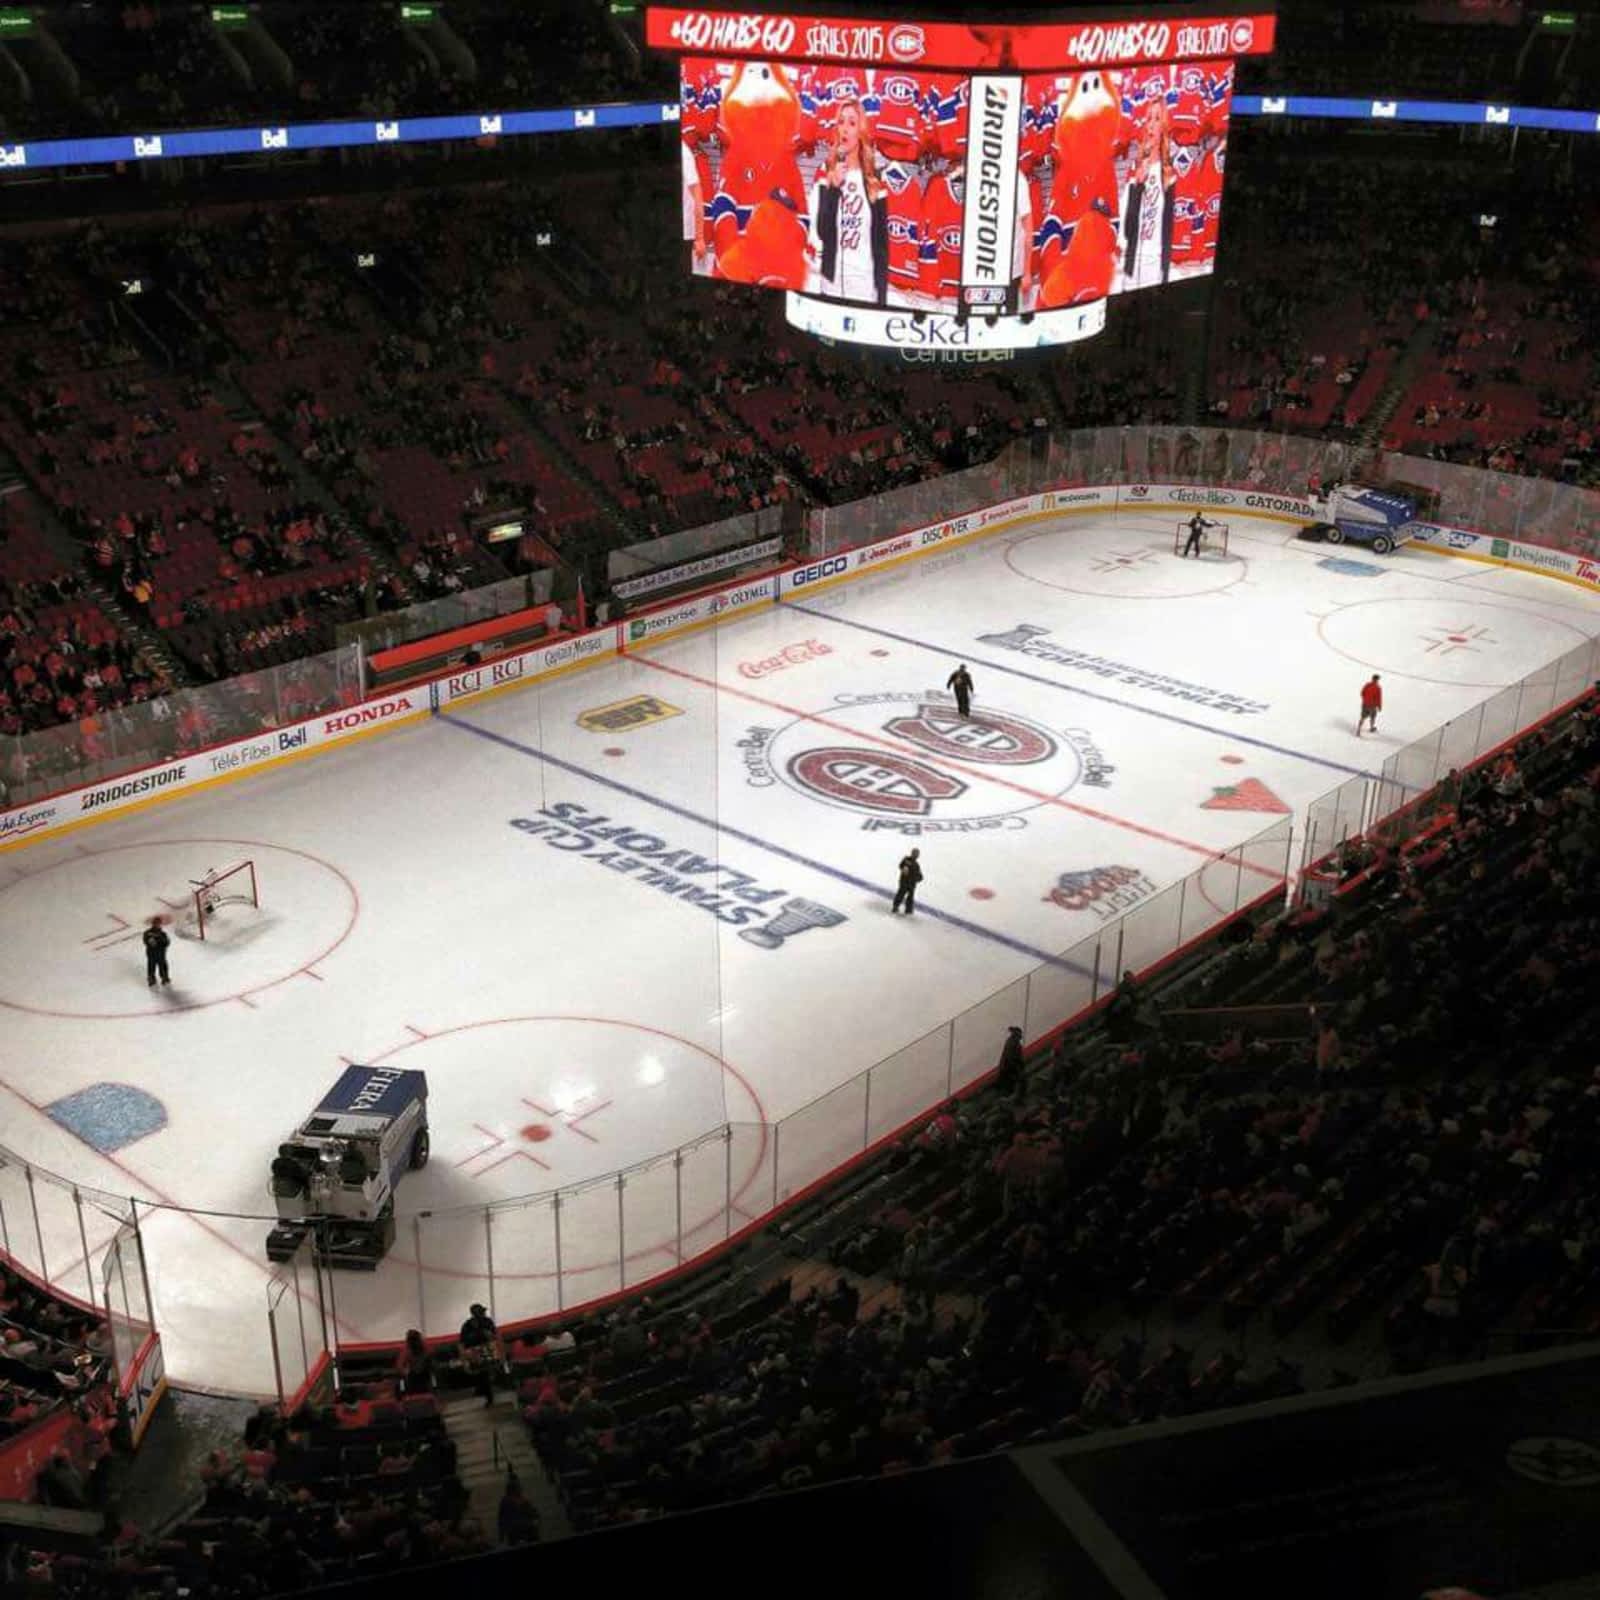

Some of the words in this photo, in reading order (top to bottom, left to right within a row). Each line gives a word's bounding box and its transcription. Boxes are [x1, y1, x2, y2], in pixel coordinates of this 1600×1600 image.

[375, 121, 399, 141] Bell
[479, 115, 502, 134] Bell
[133, 136, 162, 157] Bell
[261, 128, 288, 149] Bell
[0, 145, 26, 167] Bell
[975, 84, 1009, 280] BRIDGESTONE
[886, 316, 970, 345] eska
[1246, 496, 1316, 517] GATORAD
[922, 519, 969, 544] DISCOVER
[793, 557, 848, 586] GEICO
[1513, 545, 1573, 572] Desjardins
[730, 585, 770, 605] OLYMEL
[450, 671, 481, 697] RCI
[493, 657, 524, 681] RCI
[324, 696, 413, 735] HONDA
[279, 726, 307, 750] Bell
[81, 765, 187, 811] BRIDGESTONE
[509, 817, 597, 852] CUP
[538, 802, 789, 904] PLAYOFFS
[581, 850, 770, 927] STANLEY
